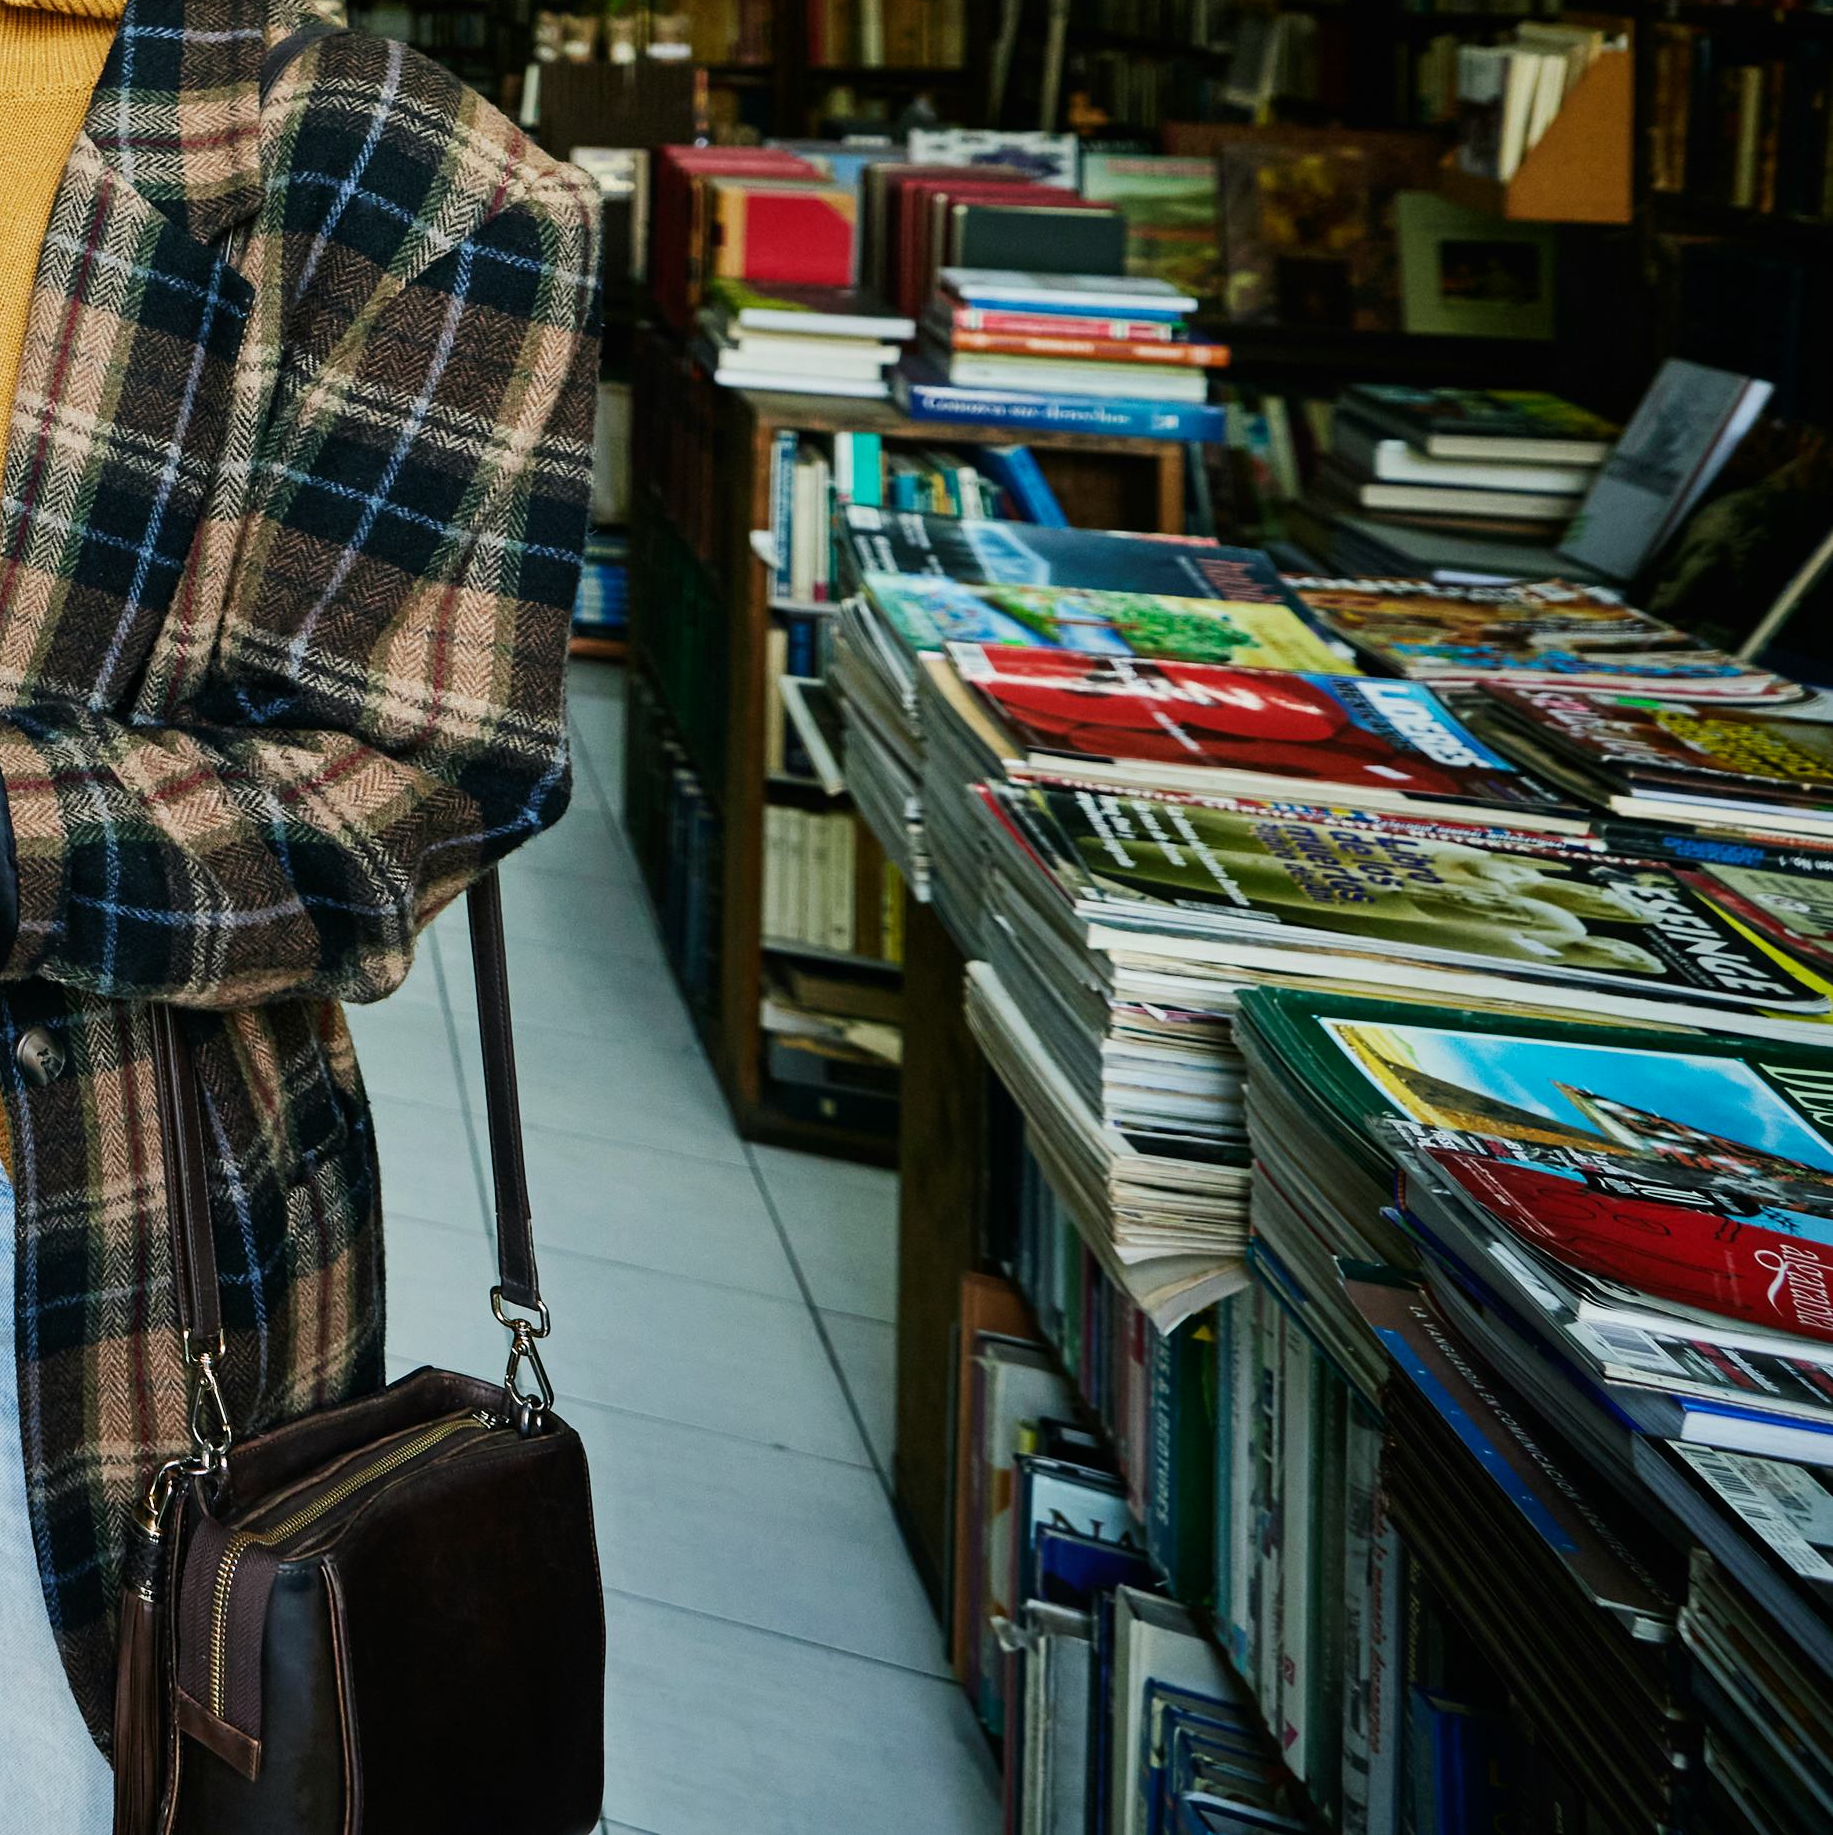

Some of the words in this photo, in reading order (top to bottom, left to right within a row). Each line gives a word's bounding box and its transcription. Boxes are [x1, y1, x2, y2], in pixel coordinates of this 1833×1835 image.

[1284, 822, 1379, 906] muertos
[1328, 828, 1376, 861] de
[1351, 856, 1406, 890] los
[1377, 833, 1446, 886] Libro
[1608, 879, 1795, 997] ESFINGE
[1408, 1304, 1421, 1318] LA
[1422, 1321, 1486, 1389] VANGUARDIA
[1480, 1391, 1498, 1409] EN
